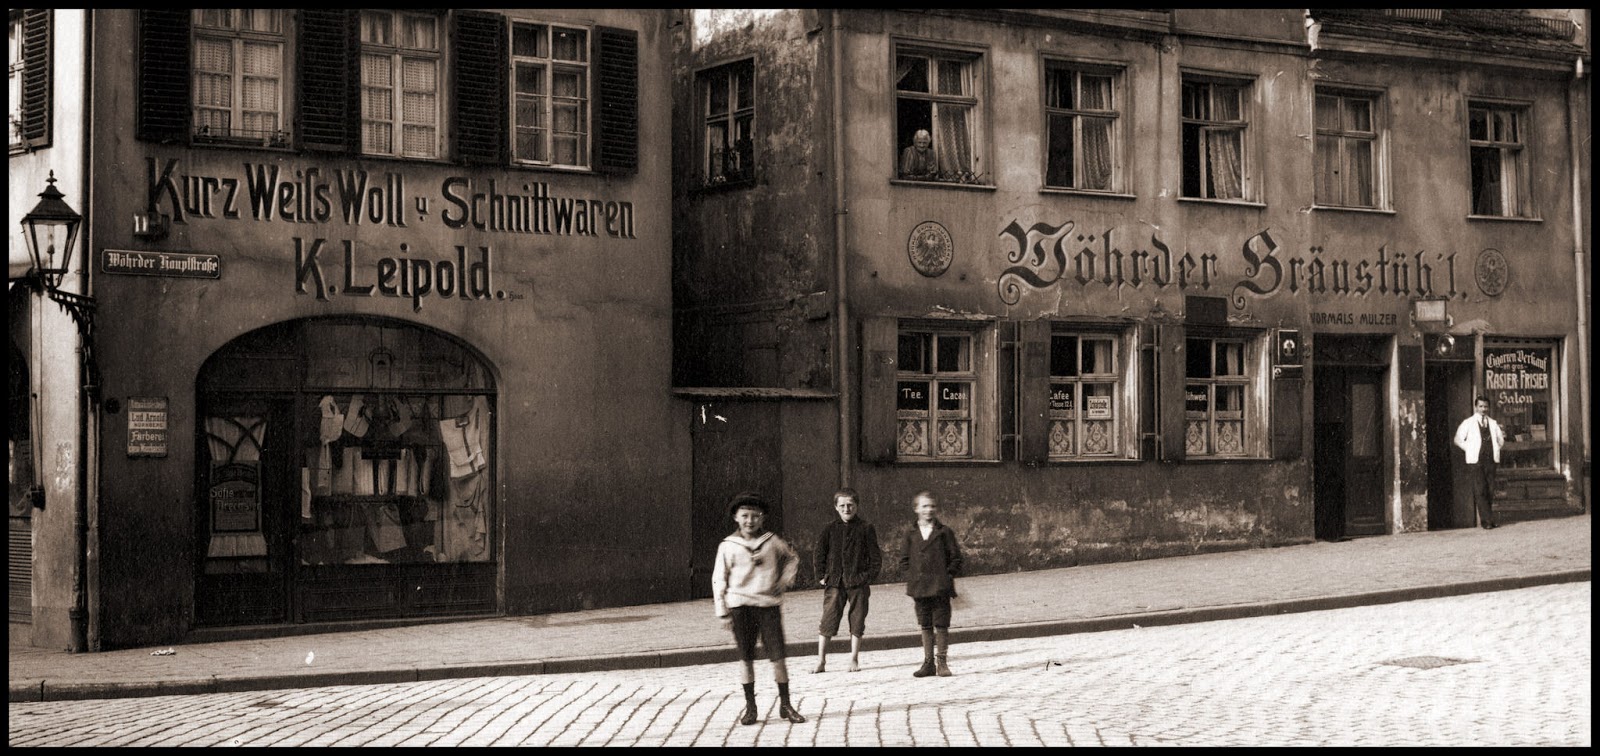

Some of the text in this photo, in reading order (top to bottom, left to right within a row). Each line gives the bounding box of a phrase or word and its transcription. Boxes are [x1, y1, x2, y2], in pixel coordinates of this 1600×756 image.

[145, 156, 242, 225] Kurz
[334, 167, 409, 228] Woll
[441, 176, 637, 240] Schnittwaren
[108, 252, 155, 269] Wöhrder
[998, 218, 1219, 306] Wöhrder
[1309, 312, 1354, 325] VORMALS
[1520, 370, 1548, 389] FRISIER
[1498, 391, 1533, 405] Salon
